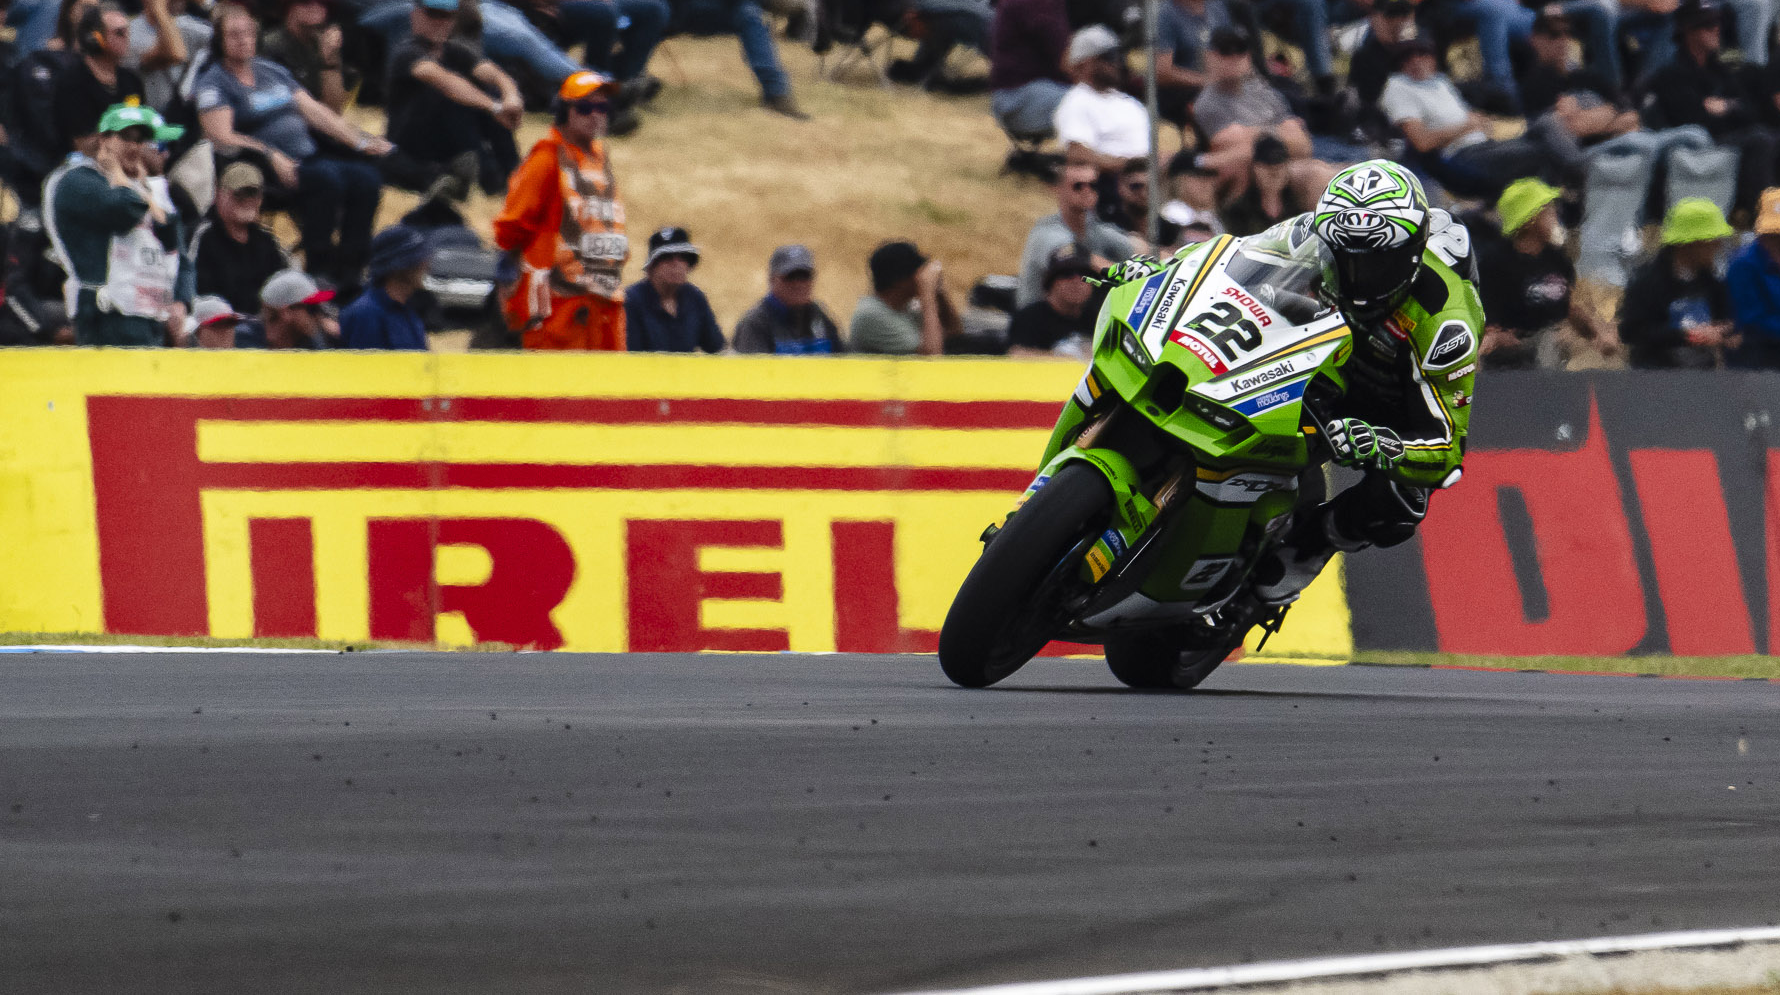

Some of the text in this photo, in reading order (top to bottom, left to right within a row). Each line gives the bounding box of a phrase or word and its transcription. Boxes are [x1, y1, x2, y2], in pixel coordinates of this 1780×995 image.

[1344, 212, 1384, 227] KYT
[1151, 277, 1188, 329] Kawasaki
[1221, 286, 1273, 328] SHOWA
[1183, 301, 1263, 363] 22
[1431, 331, 1469, 361] RST
[1177, 335, 1220, 369] MOTUL
[1231, 360, 1295, 393] Kawasaki
[1447, 363, 1476, 382] MOTU
[86, 396, 1243, 656] PIREL
